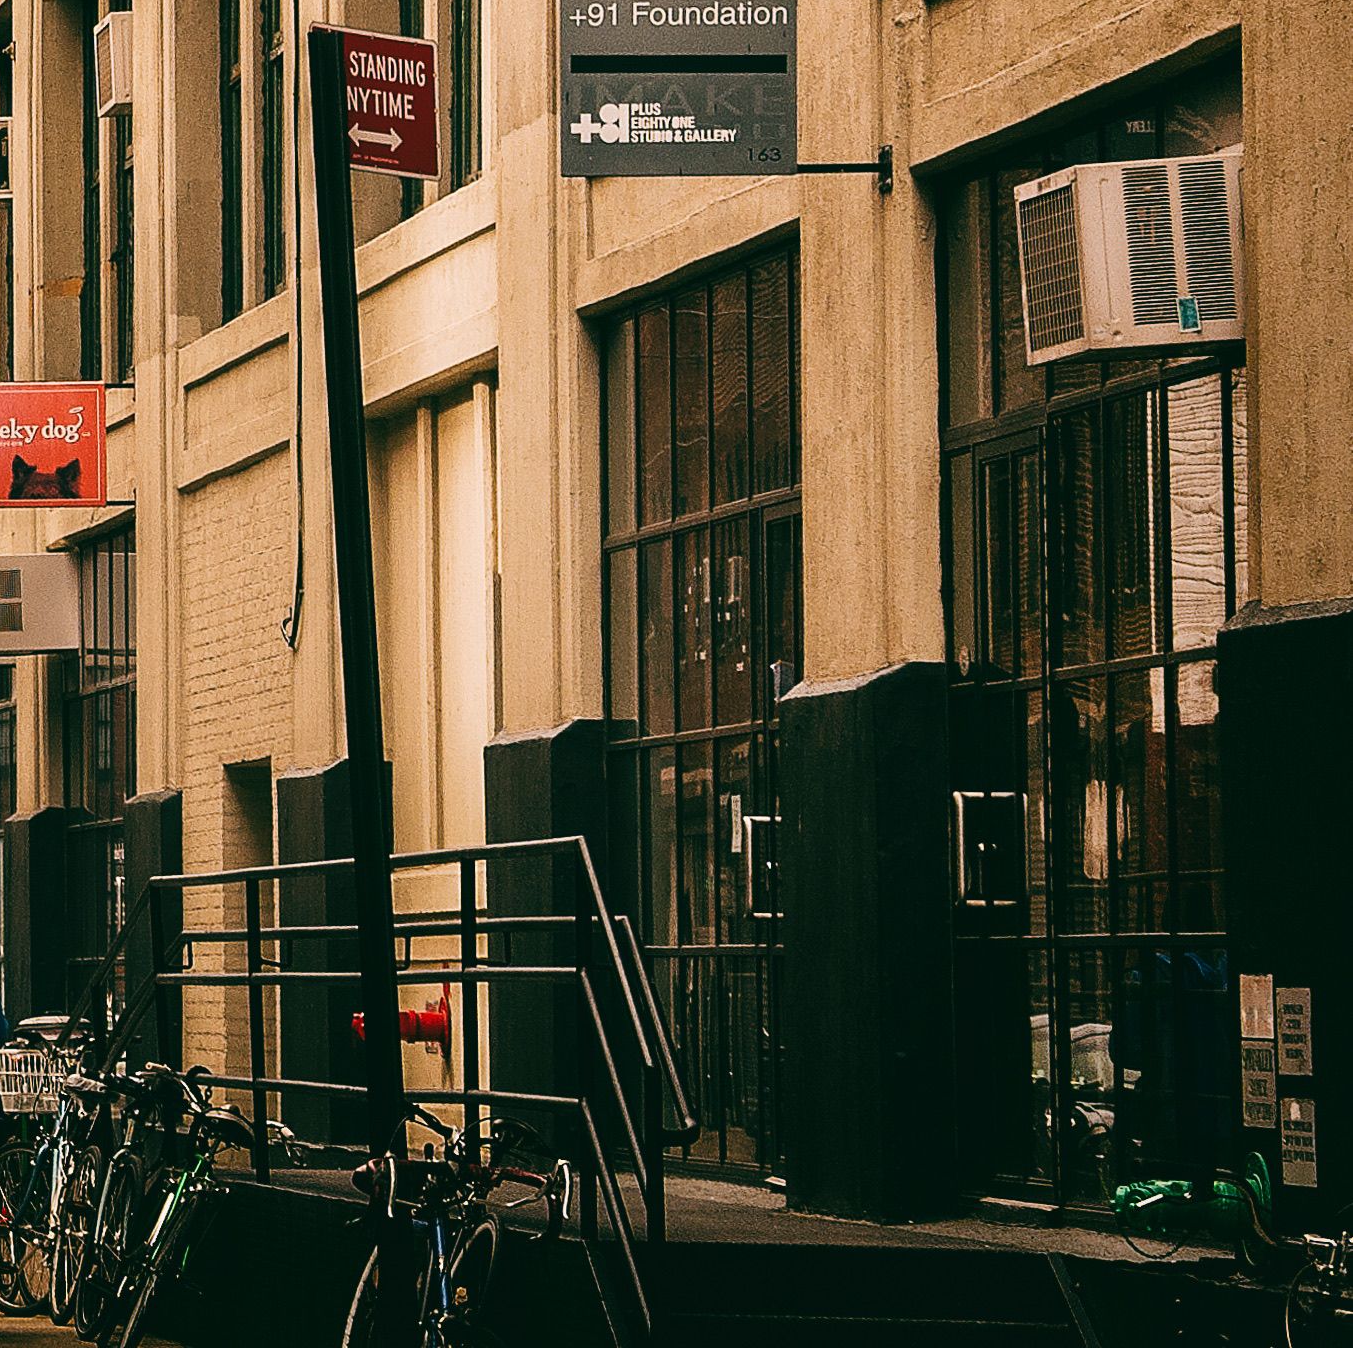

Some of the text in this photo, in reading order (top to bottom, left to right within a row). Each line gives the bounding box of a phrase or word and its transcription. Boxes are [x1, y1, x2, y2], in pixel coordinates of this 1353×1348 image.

[569, 2, 789, 27] +91 Foundation
[349, 50, 426, 88] STANDING
[346, 85, 416, 121] NYTIME
[631, 103, 662, 116] PLUS
[631, 116, 696, 129] EIGHTY ONE
[630, 129, 673, 143] STUDIO
[674, 130, 684, 143] &
[684, 129, 737, 143] GALLERY
[748, 147, 783, 163] 163
[41, 409, 85, 444] dog
